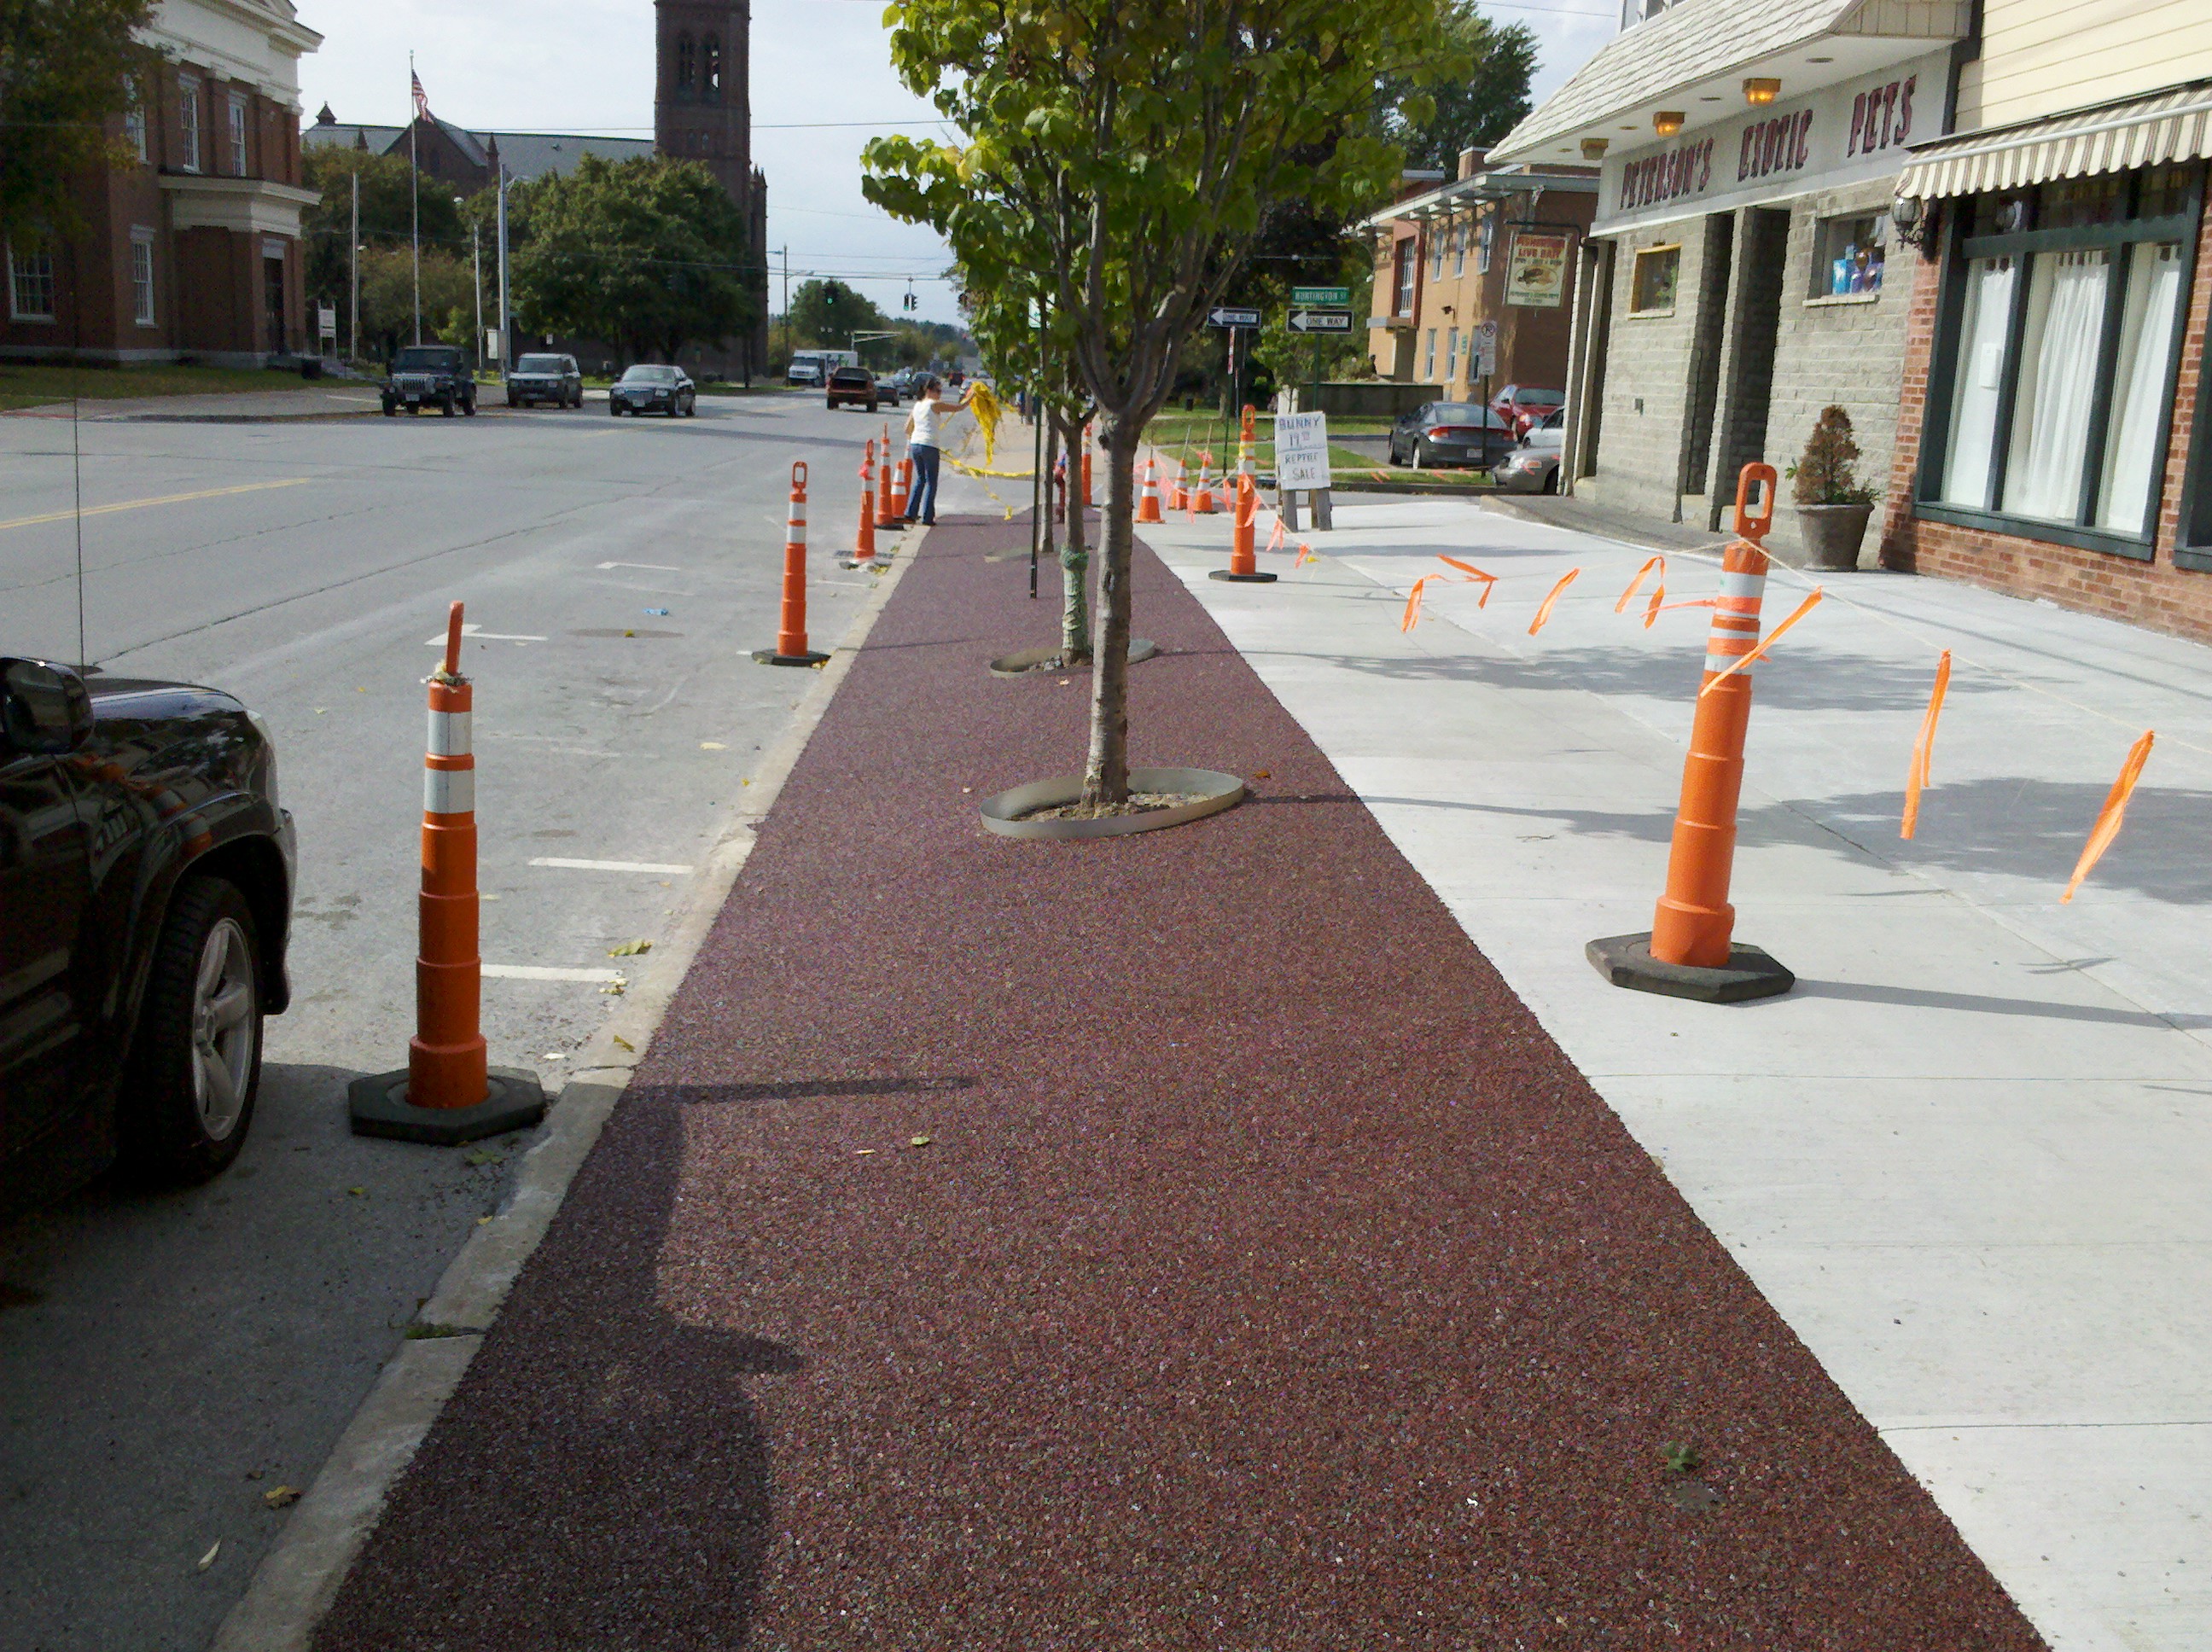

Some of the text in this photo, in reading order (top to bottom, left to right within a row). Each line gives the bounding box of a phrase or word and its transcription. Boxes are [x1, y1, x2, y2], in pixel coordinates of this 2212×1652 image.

[1620, 74, 1917, 210] PETERSON'S EXOTIC PETS
[1239, 313, 1254, 322] WAY
[1306, 317, 1345, 325] ONE WAY
[1278, 416, 1321, 430] BUNNY
[1292, 467, 1316, 481] SALE
